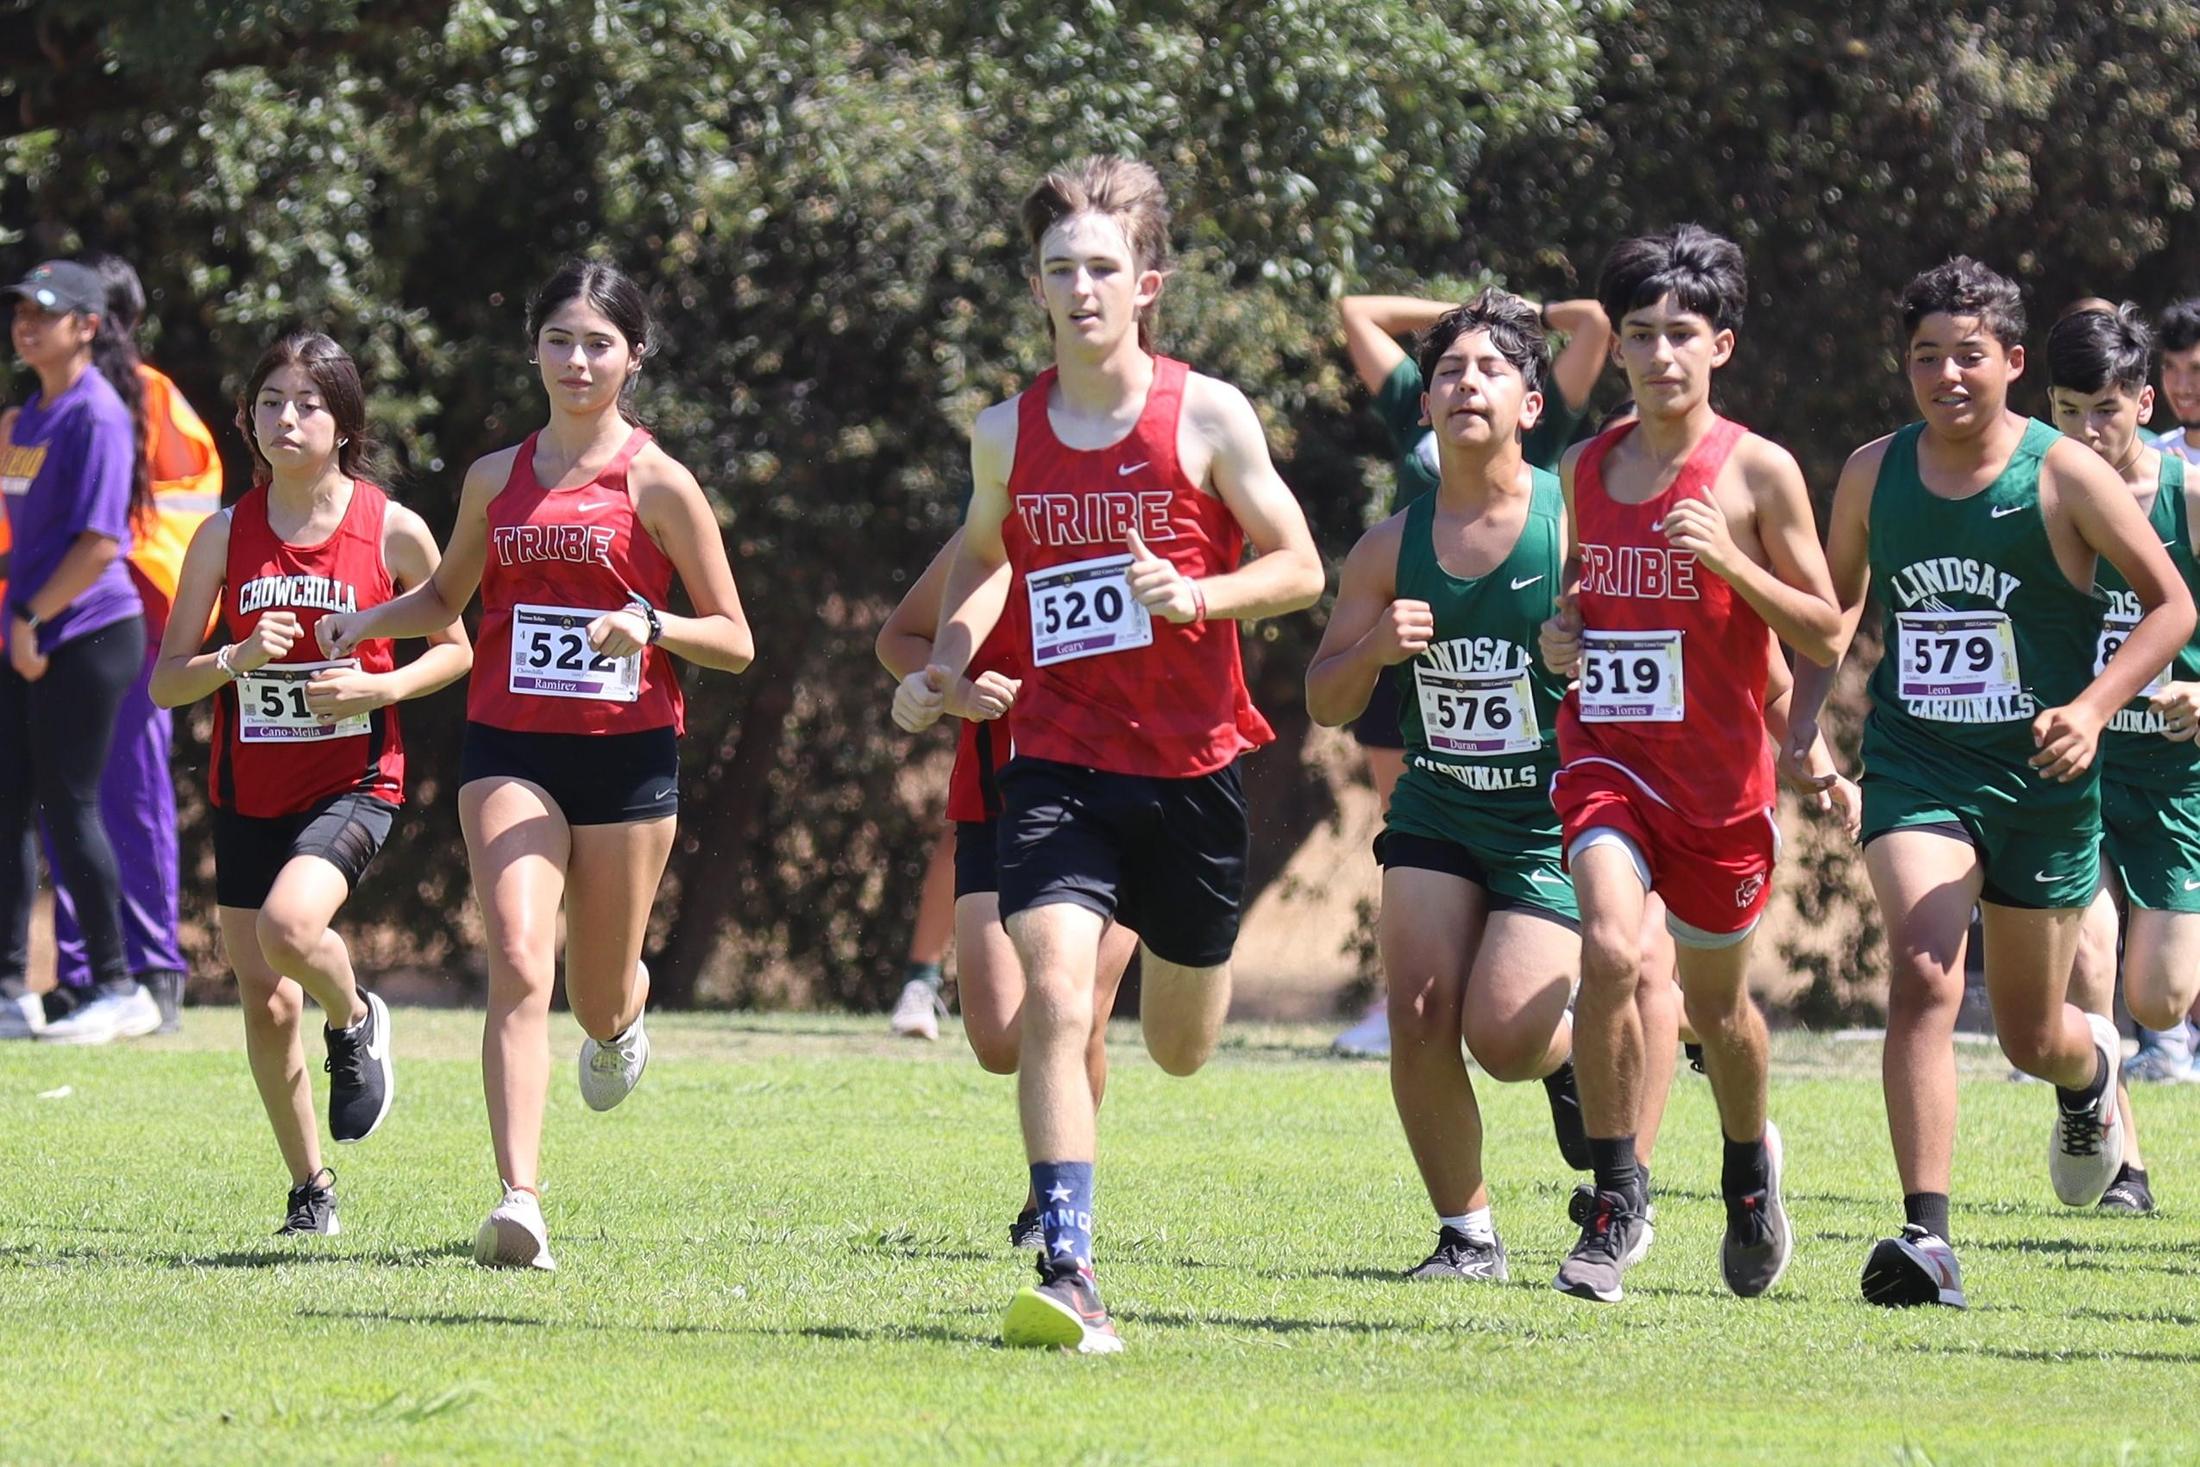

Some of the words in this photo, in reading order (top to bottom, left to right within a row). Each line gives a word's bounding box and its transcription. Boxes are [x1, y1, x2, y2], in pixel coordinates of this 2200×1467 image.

[1016, 490, 1177, 546] TRIBE
[494, 525, 616, 567] TRIBE
[239, 575, 358, 616] CHOWCHILLA
[1891, 556, 2022, 611] LINDSAY
[1044, 585, 1123, 634] 520
[1056, 640, 1085, 655] Geary
[1915, 636, 1994, 674] 579
[1585, 658, 1660, 694] 519
[1927, 685, 1952, 696] Leon
[260, 685, 312, 718] 51
[1437, 694, 1512, 731] 576
[1907, 693, 2036, 724] CARDINALS
[1449, 739, 1478, 752] Duran
